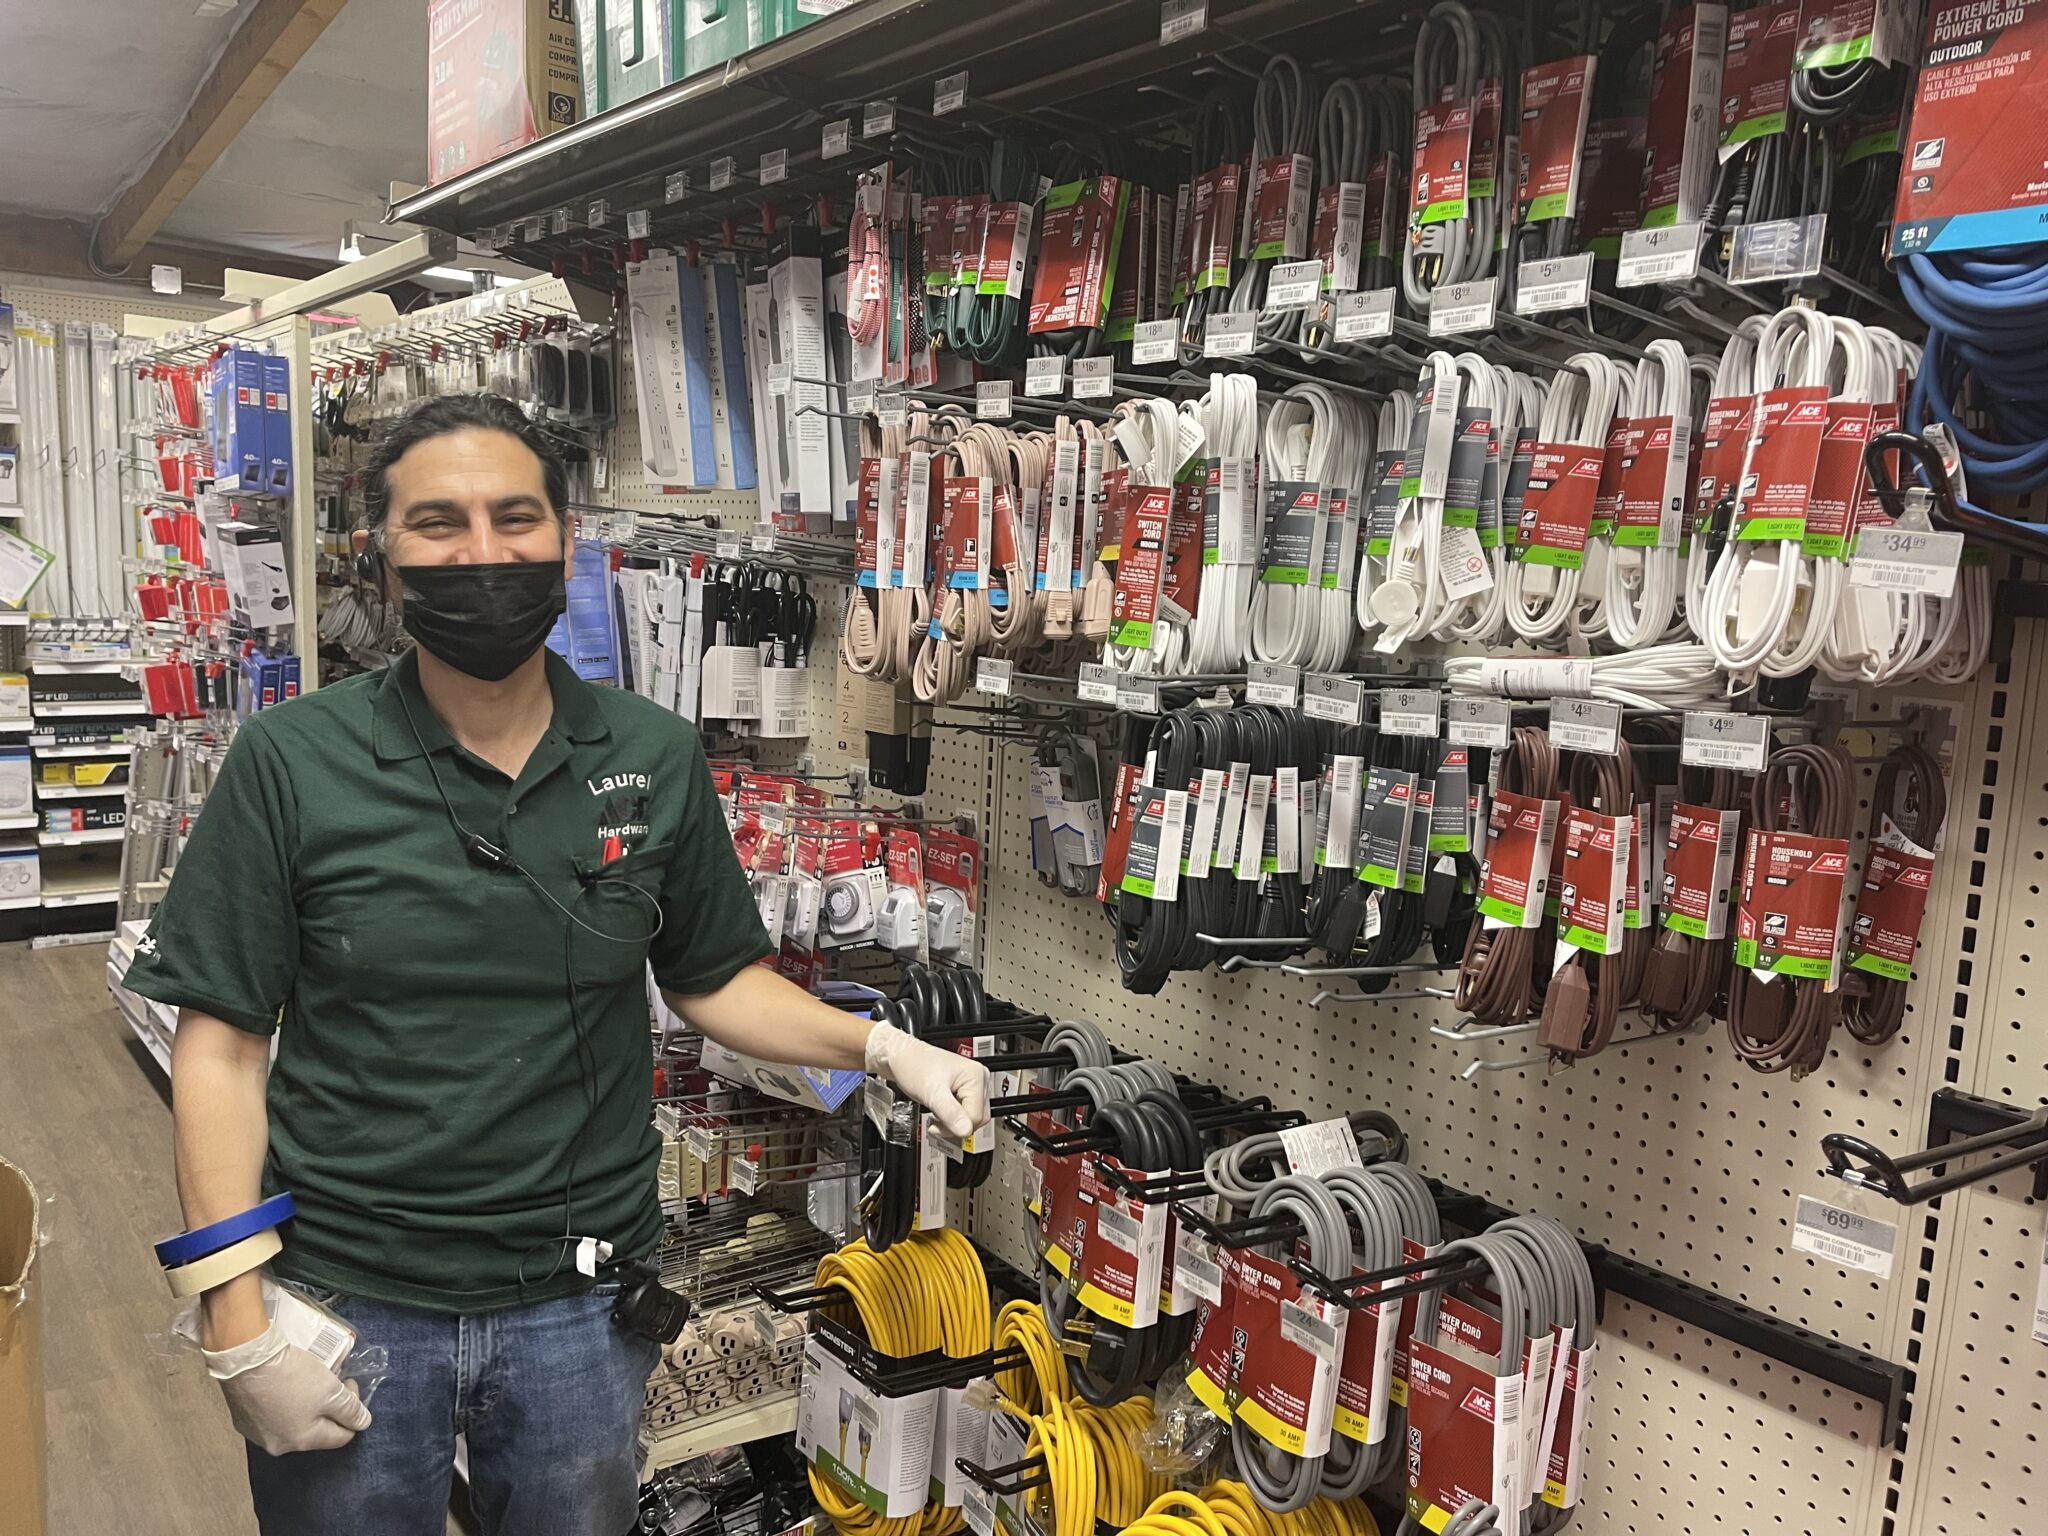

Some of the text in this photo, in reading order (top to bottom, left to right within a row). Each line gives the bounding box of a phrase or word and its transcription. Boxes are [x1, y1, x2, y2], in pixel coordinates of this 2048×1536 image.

[1936, 1, 2000, 27] EXTREME
[1776, 14, 1797, 27] ACE
[1934, 8, 2024, 43] POWER CORD
[549, 33, 562, 44] AIR
[1681, 29, 1692, 43] ACE
[1929, 40, 1983, 64] OUTDOOR
[1927, 50, 2032, 81] CABLE DE ALIMENTACIÓN DE
[1526, 76, 1559, 91] REPLACEMENT
[1567, 76, 1581, 87] ACE
[1924, 65, 2015, 92] ALTA RESISTENCIA PARA
[1923, 84, 1977, 102] USO EXTERIOR
[1451, 111, 1467, 122] ACE
[1277, 166, 1290, 175] ACE
[1221, 179, 1236, 187] ACE
[1901, 226, 1928, 241] 25 ft
[1086, 249, 1096, 282] WORKSHOP
[1092, 231, 1100, 248] CORD
[1709, 410, 1740, 418] HOUSEHOLD
[1799, 406, 1821, 416] ACE
[1474, 422, 1487, 430] ACE
[1841, 421, 1862, 432] ACE
[1654, 432, 1667, 441] ACE
[1533, 460, 1548, 469] CORD
[1535, 454, 1565, 463] HOUSEHOLD
[1581, 463, 1599, 472] ACE
[1528, 481, 1548, 489] INDOOR
[1146, 499, 1165, 509] ACE
[1137, 519, 1162, 531] SWITCH
[1143, 529, 1161, 539] CORD
[1140, 540, 1159, 549] INDOOR
[1823, 539, 1839, 547] DUTY
[1136, 628, 1148, 637] DUTY
[842, 711, 849, 723] 2
[588, 773, 651, 796] Laurel
[1117, 766, 1126, 797] WORKSHOP
[103, 812, 125, 825] LED
[1523, 815, 1536, 823] ACE
[1671, 814, 1693, 825] HOUSEHOLD
[1570, 820, 1594, 832] HOUSEHOLD
[1700, 825, 1716, 834] ACE
[1598, 833, 1611, 842] ACE
[889, 849, 907, 863] EZ-SET
[928, 848, 958, 865] EZ-SET
[1750, 834, 1758, 869] HOUSEHOLD
[1772, 847, 1812, 858] HOUSEHOLD
[1771, 854, 1790, 862] CORD
[1823, 858, 1842, 867] ACE
[1873, 856, 1900, 870] HOUSEHOLD
[1871, 862, 1885, 870] CORD
[1907, 872, 1927, 882] ACE
[1743, 920, 1751, 935] ACE
[1583, 933, 1604, 943] LIGHT DUTY
[783, 957, 809, 973] EZ-SET
[1879, 962, 1906, 973] LIGHT DUTY
[1219, 1247, 1233, 1268] DRYER
[1241, 1272, 1258, 1287] 3-WIRE
[1242, 1262, 1281, 1290] DRYER CORD
[1120, 1305, 1130, 1315] AMP
[1461, 1323, 1481, 1340] CORD
[819, 1326, 856, 1356] MONSTER
[1411, 1357, 1451, 1384] DRYER CORD
[1411, 1369, 1429, 1383] 3-WIRE
[1392, 1383, 1403, 1392] AMP
[1473, 1394, 1491, 1410] ACE
[1344, 1415, 1364, 1428] 30 AMP
[1280, 1428, 1301, 1442] 30 AMP
[832, 1463, 857, 1489] 100ft.
[1547, 1486, 1560, 1496] AMP
